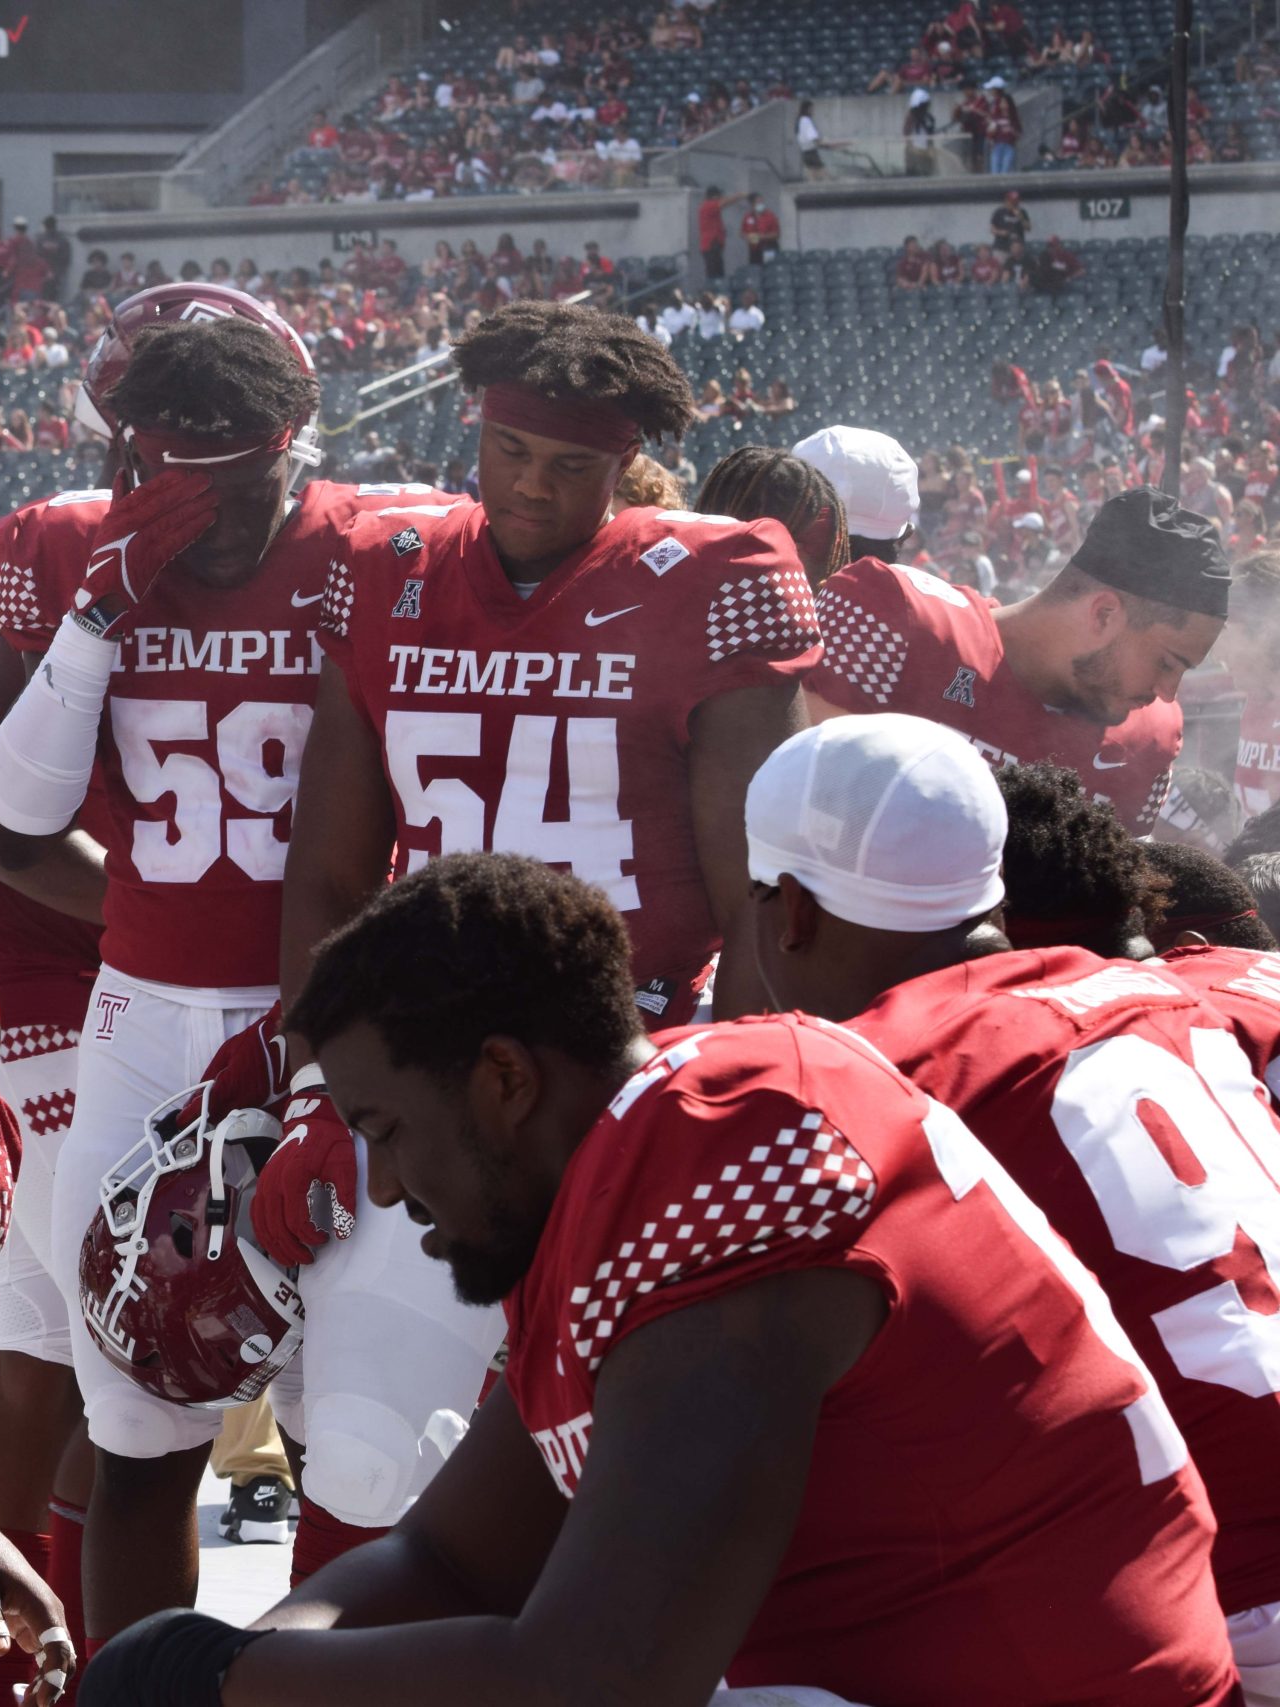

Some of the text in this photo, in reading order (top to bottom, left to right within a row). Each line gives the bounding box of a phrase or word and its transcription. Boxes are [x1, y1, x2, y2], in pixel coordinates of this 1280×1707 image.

[1086, 198, 1124, 218] 107
[388, 644, 636, 700] TEMPLE
[109, 696, 316, 884] 59
[384, 709, 642, 912] 54
